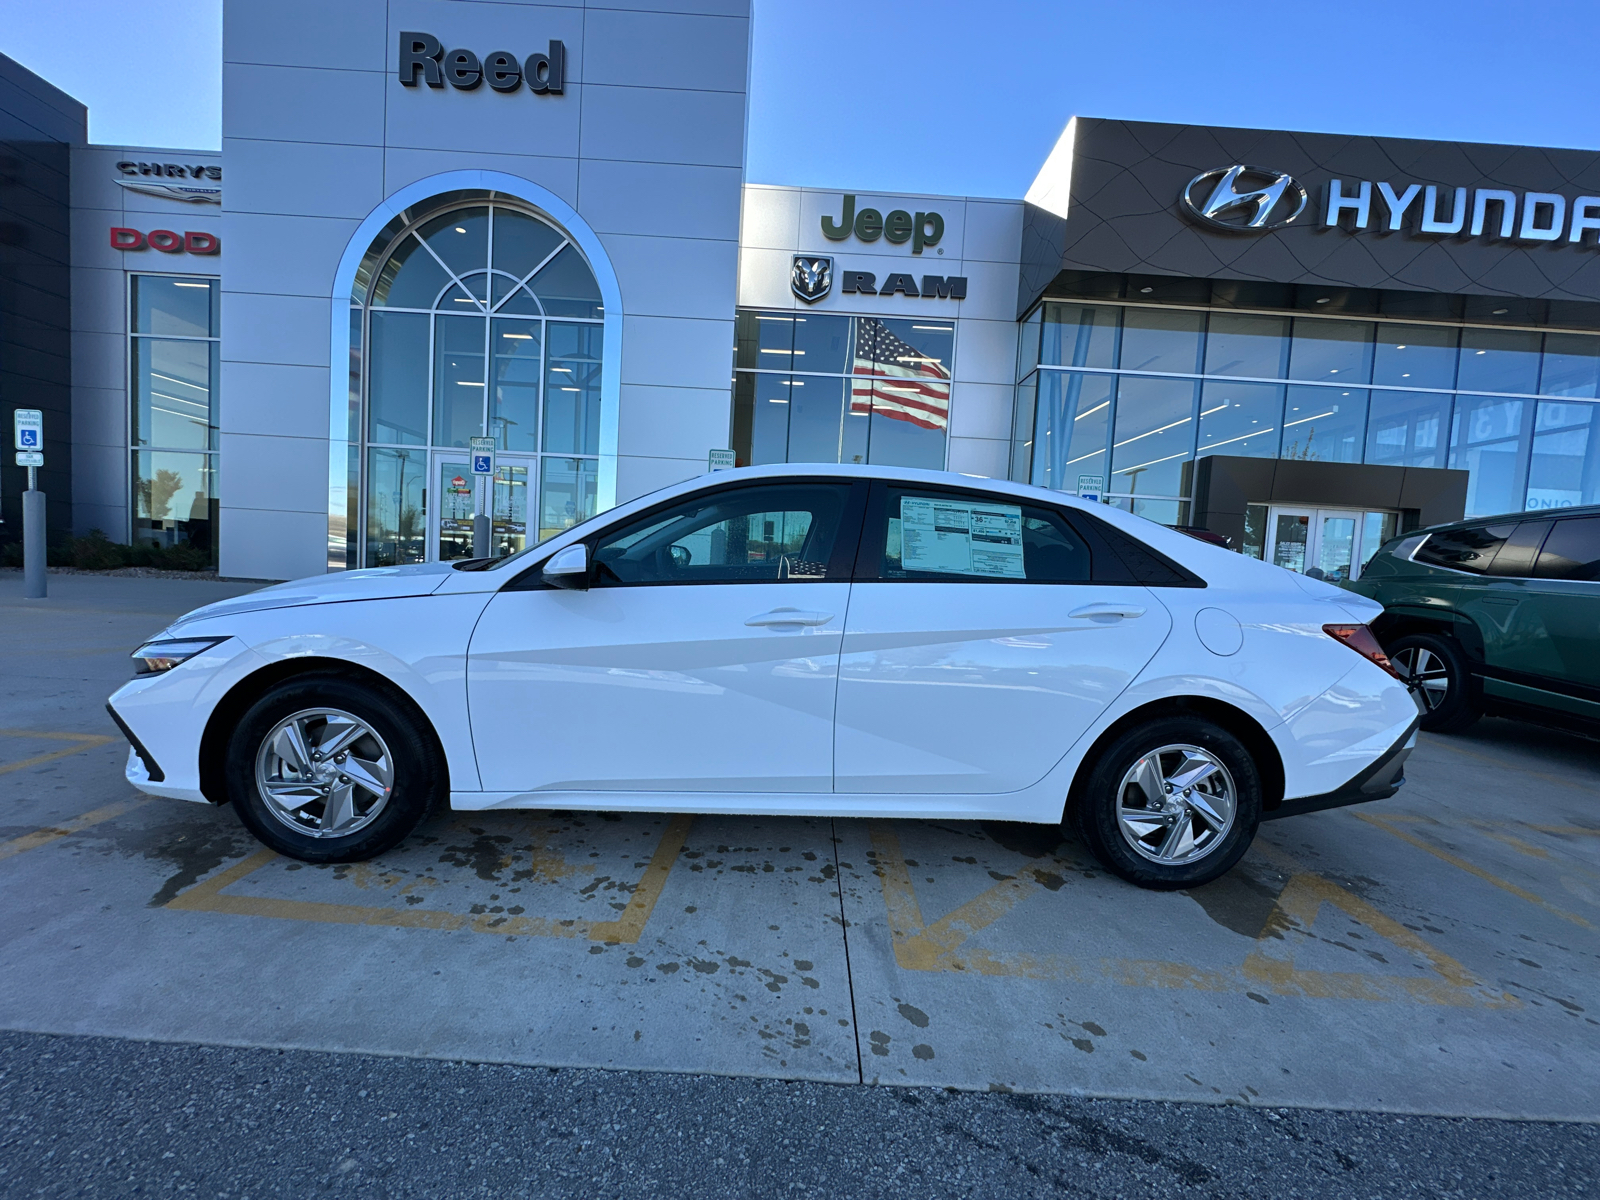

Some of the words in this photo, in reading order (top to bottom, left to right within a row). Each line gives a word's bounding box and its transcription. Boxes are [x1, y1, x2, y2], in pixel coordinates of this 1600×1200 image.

[399, 31, 566, 95] Reed
[116, 161, 221, 180] CHRYS
[820, 194, 945, 254] Jeep
[110, 227, 221, 255] DOD
[842, 270, 968, 299] RAM
